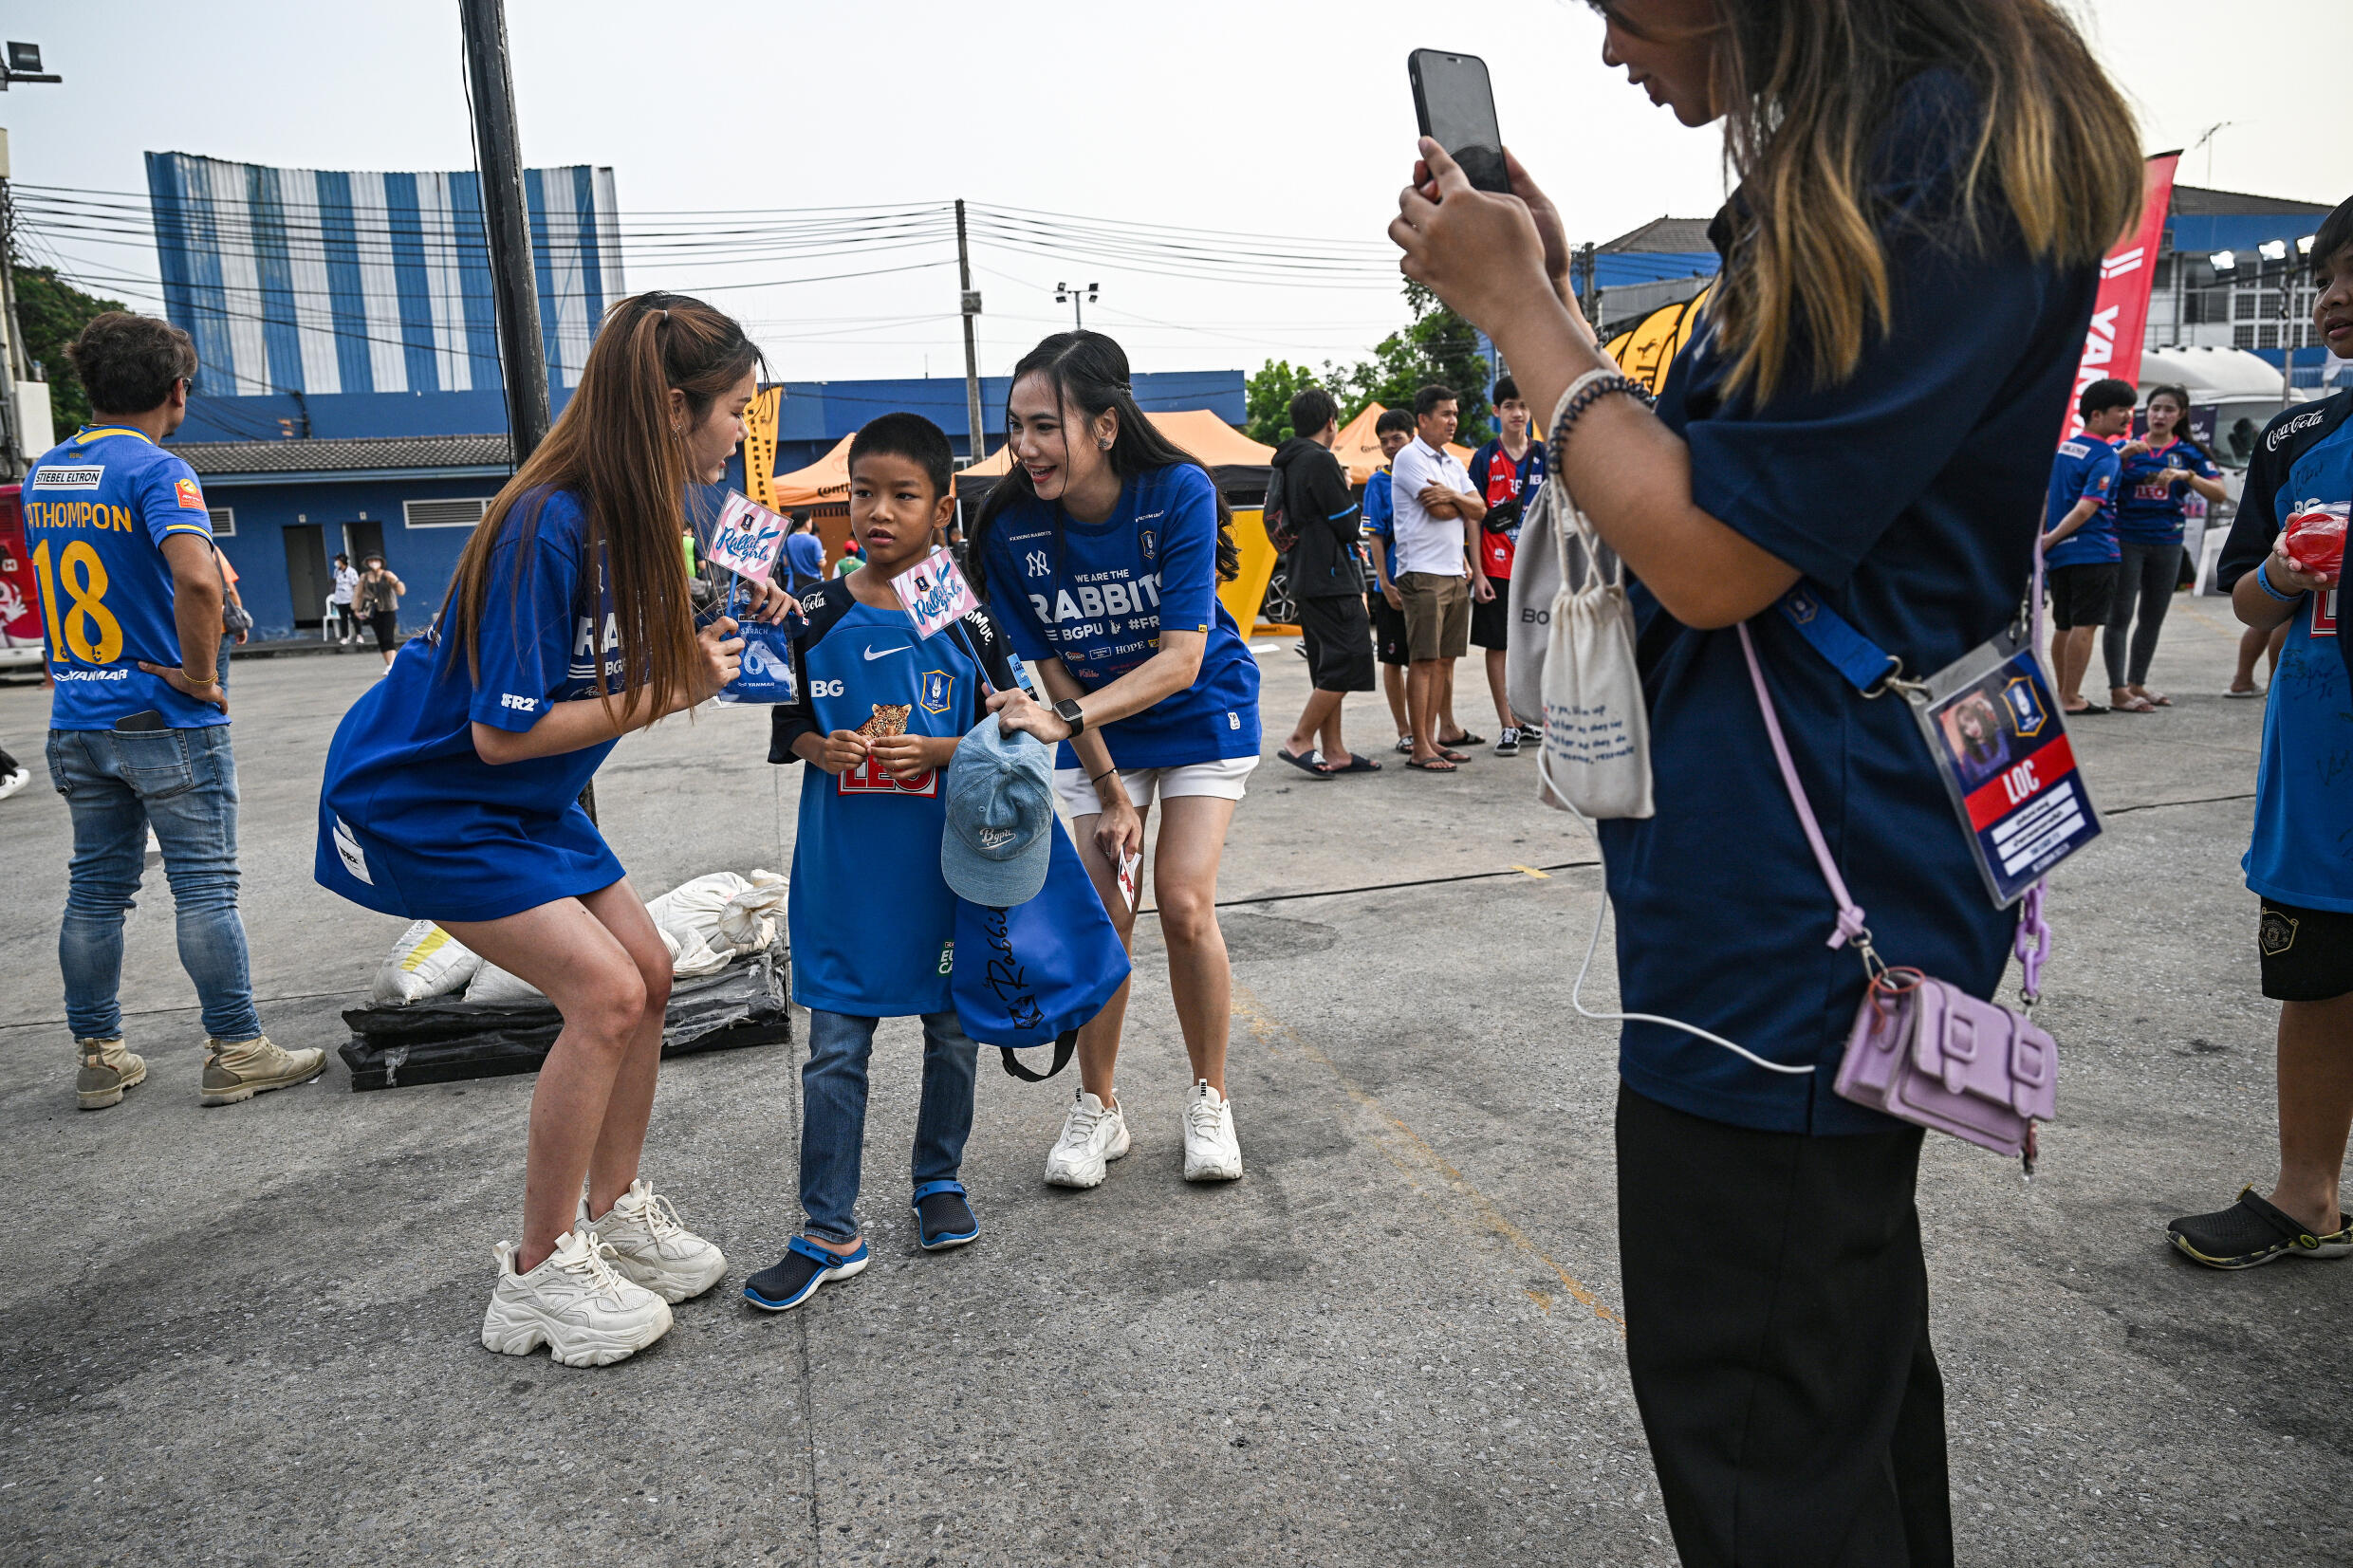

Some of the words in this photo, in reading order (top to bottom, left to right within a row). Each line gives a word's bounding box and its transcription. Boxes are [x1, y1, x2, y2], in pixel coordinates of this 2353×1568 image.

[36, 472, 65, 483] STIEBEL
[66, 472, 100, 482] ELTRON
[740, 545, 769, 563] girls
[1075, 574, 1090, 583] WE
[1091, 572, 1109, 582] ARE
[1109, 569, 1130, 581] THE
[33, 538, 123, 665] 18
[1062, 622, 1103, 641] BGPU
[1115, 641, 1144, 655] HOPE
[743, 640, 765, 675] 6
[69, 669, 129, 682] YANMAR
[810, 679, 844, 698] BG
[2003, 759, 2040, 804] LOC
